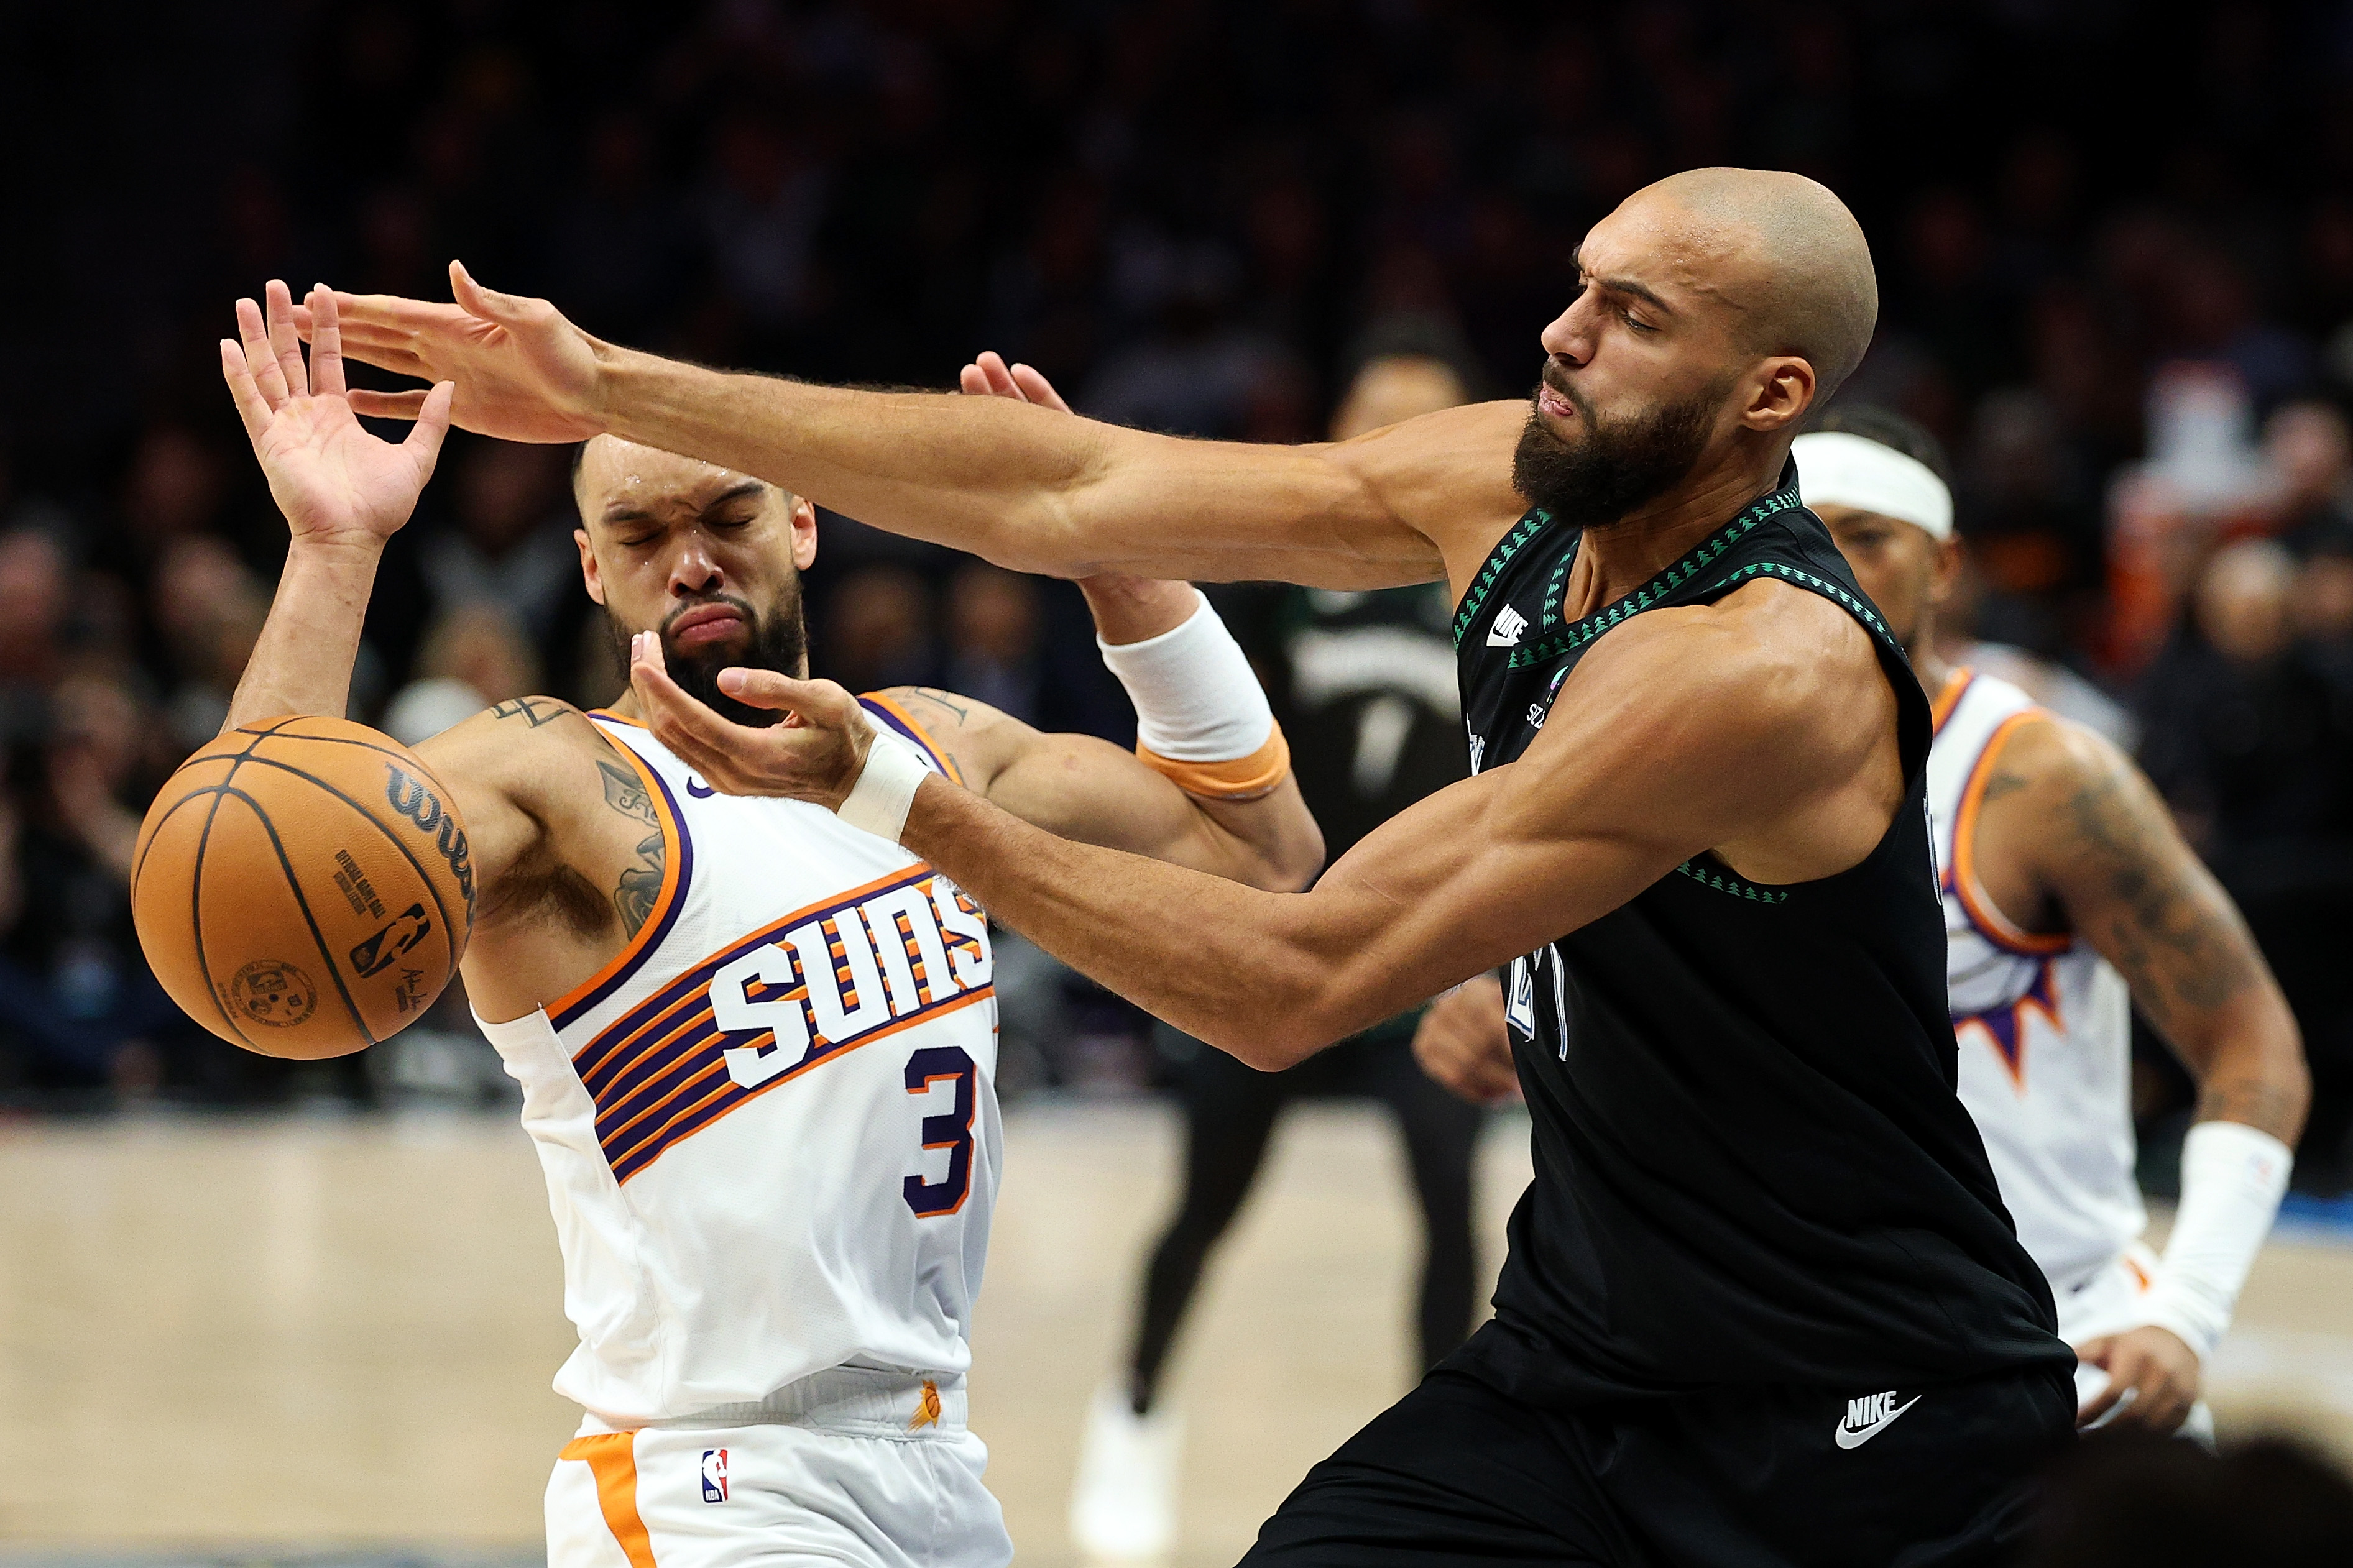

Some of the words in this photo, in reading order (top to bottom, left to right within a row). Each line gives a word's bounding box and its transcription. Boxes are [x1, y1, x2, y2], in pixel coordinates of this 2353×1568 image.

[1493, 603, 1529, 643] NIKE
[385, 761, 477, 926] Wil
[903, 1045, 977, 1219] 3
[1846, 1390, 1897, 1429] NIKE
[705, 1489, 719, 1501] NBA
